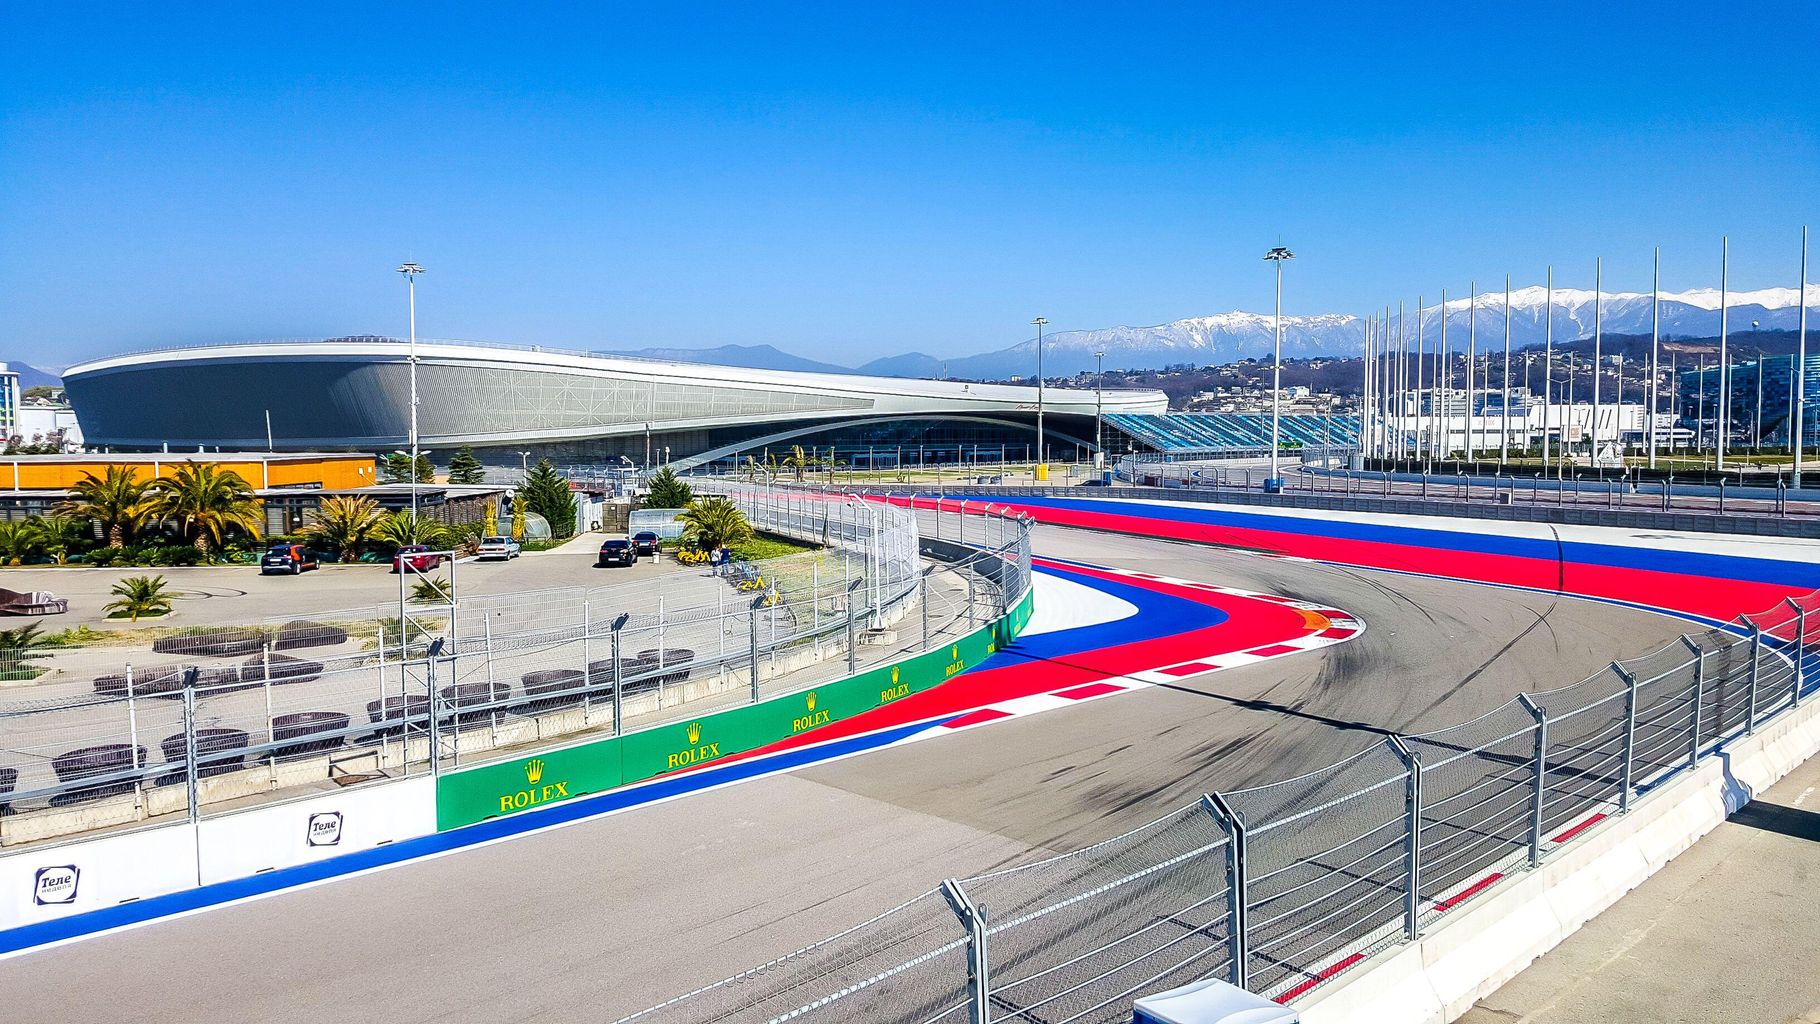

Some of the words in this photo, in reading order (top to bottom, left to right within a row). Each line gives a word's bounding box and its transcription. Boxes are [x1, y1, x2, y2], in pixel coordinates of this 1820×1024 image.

[945, 659, 964, 676] ROLEX
[880, 683, 910, 702] ROLEX
[793, 710, 830, 732] ROLEX
[667, 742, 720, 769] ROLEX
[500, 782, 568, 812] ROLEX
[313, 821, 336, 832] Теле
[42, 875, 71, 888] Теле
